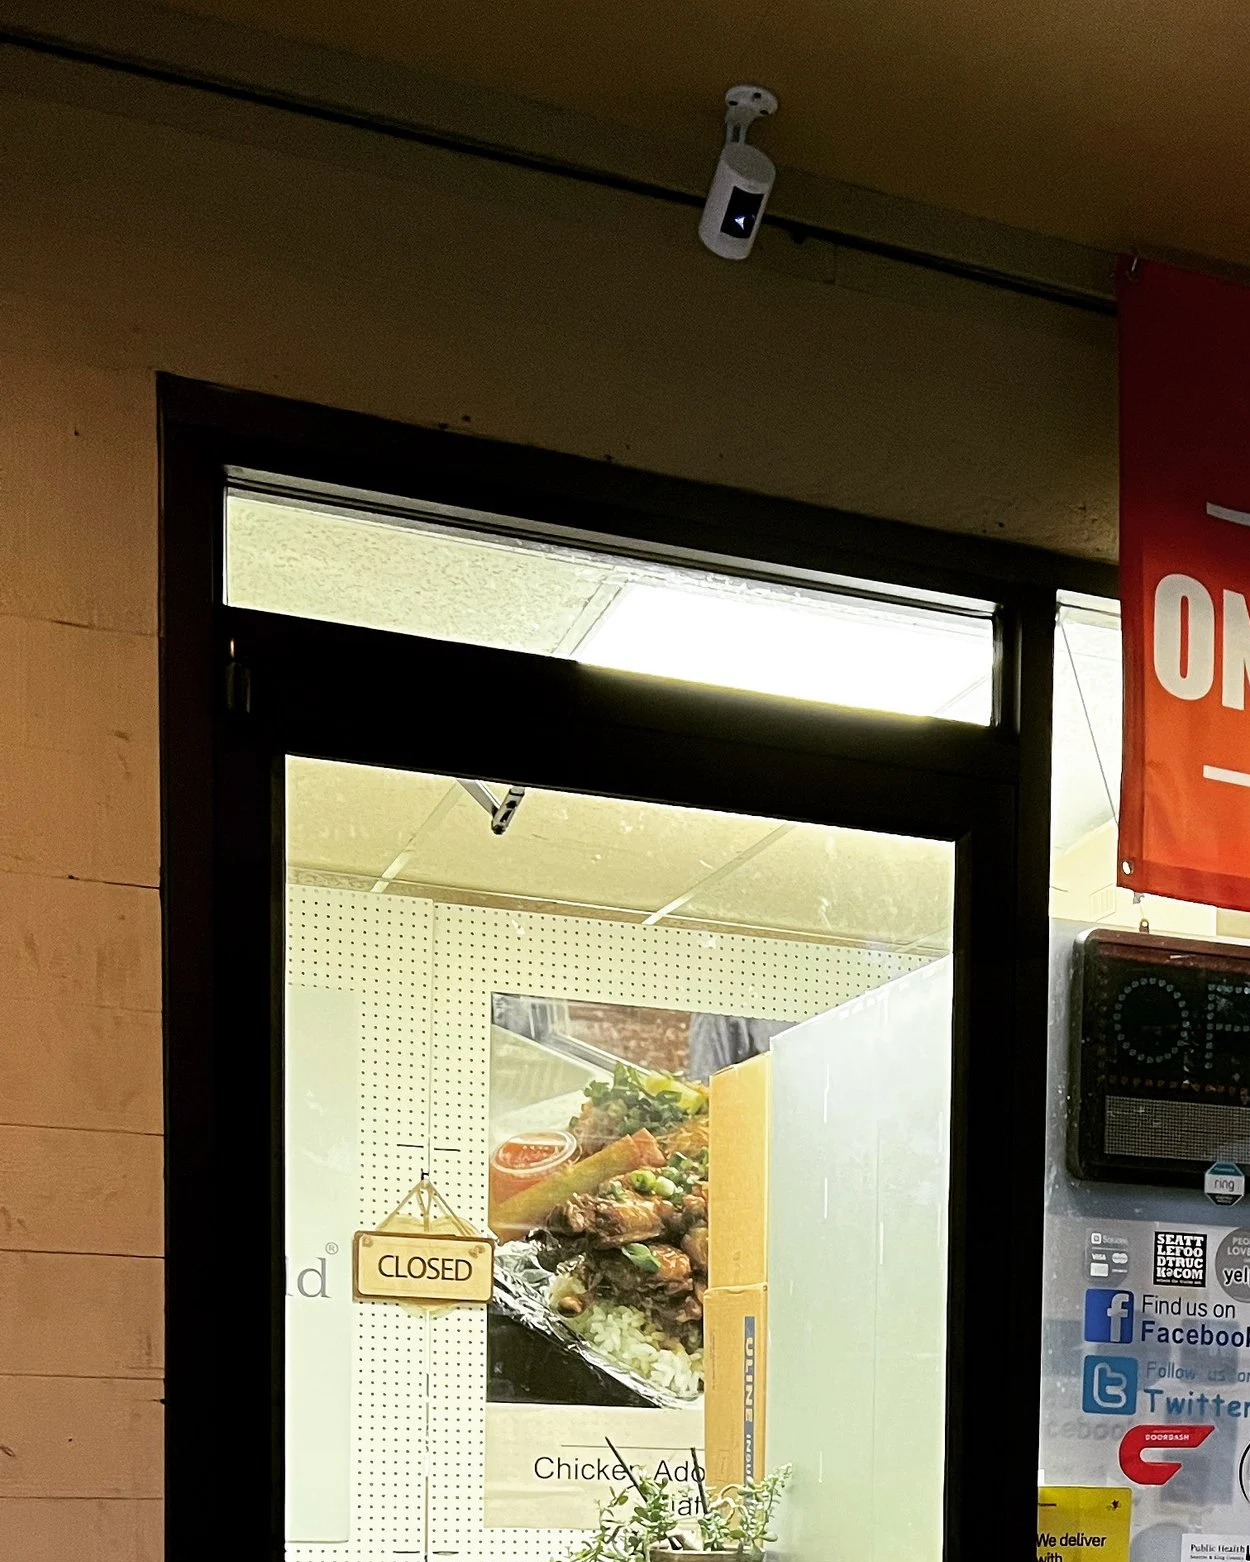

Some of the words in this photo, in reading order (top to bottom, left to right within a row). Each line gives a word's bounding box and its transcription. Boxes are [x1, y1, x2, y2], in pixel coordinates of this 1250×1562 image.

[1214, 1179, 1235, 1192] ring
[1157, 1234, 1204, 1246] SEATT
[1157, 1245, 1203, 1257] LEFOO
[378, 1255, 473, 1282] CLOSED
[1157, 1256, 1203, 1268] DTRUC
[1141, 1295, 1181, 1316] Find
[1186, 1302, 1207, 1317] us
[1213, 1303, 1235, 1319] on
[1146, 1361, 1195, 1380] Follow
[1208, 1368, 1225, 1383] us
[744, 1337, 754, 1422] ULINE
[1036, 1533, 1057, 1547] We
[1060, 1533, 1107, 1547] deliver
[1190, 1544, 1216, 1552] Public
[1218, 1545, 1245, 1554] Health
